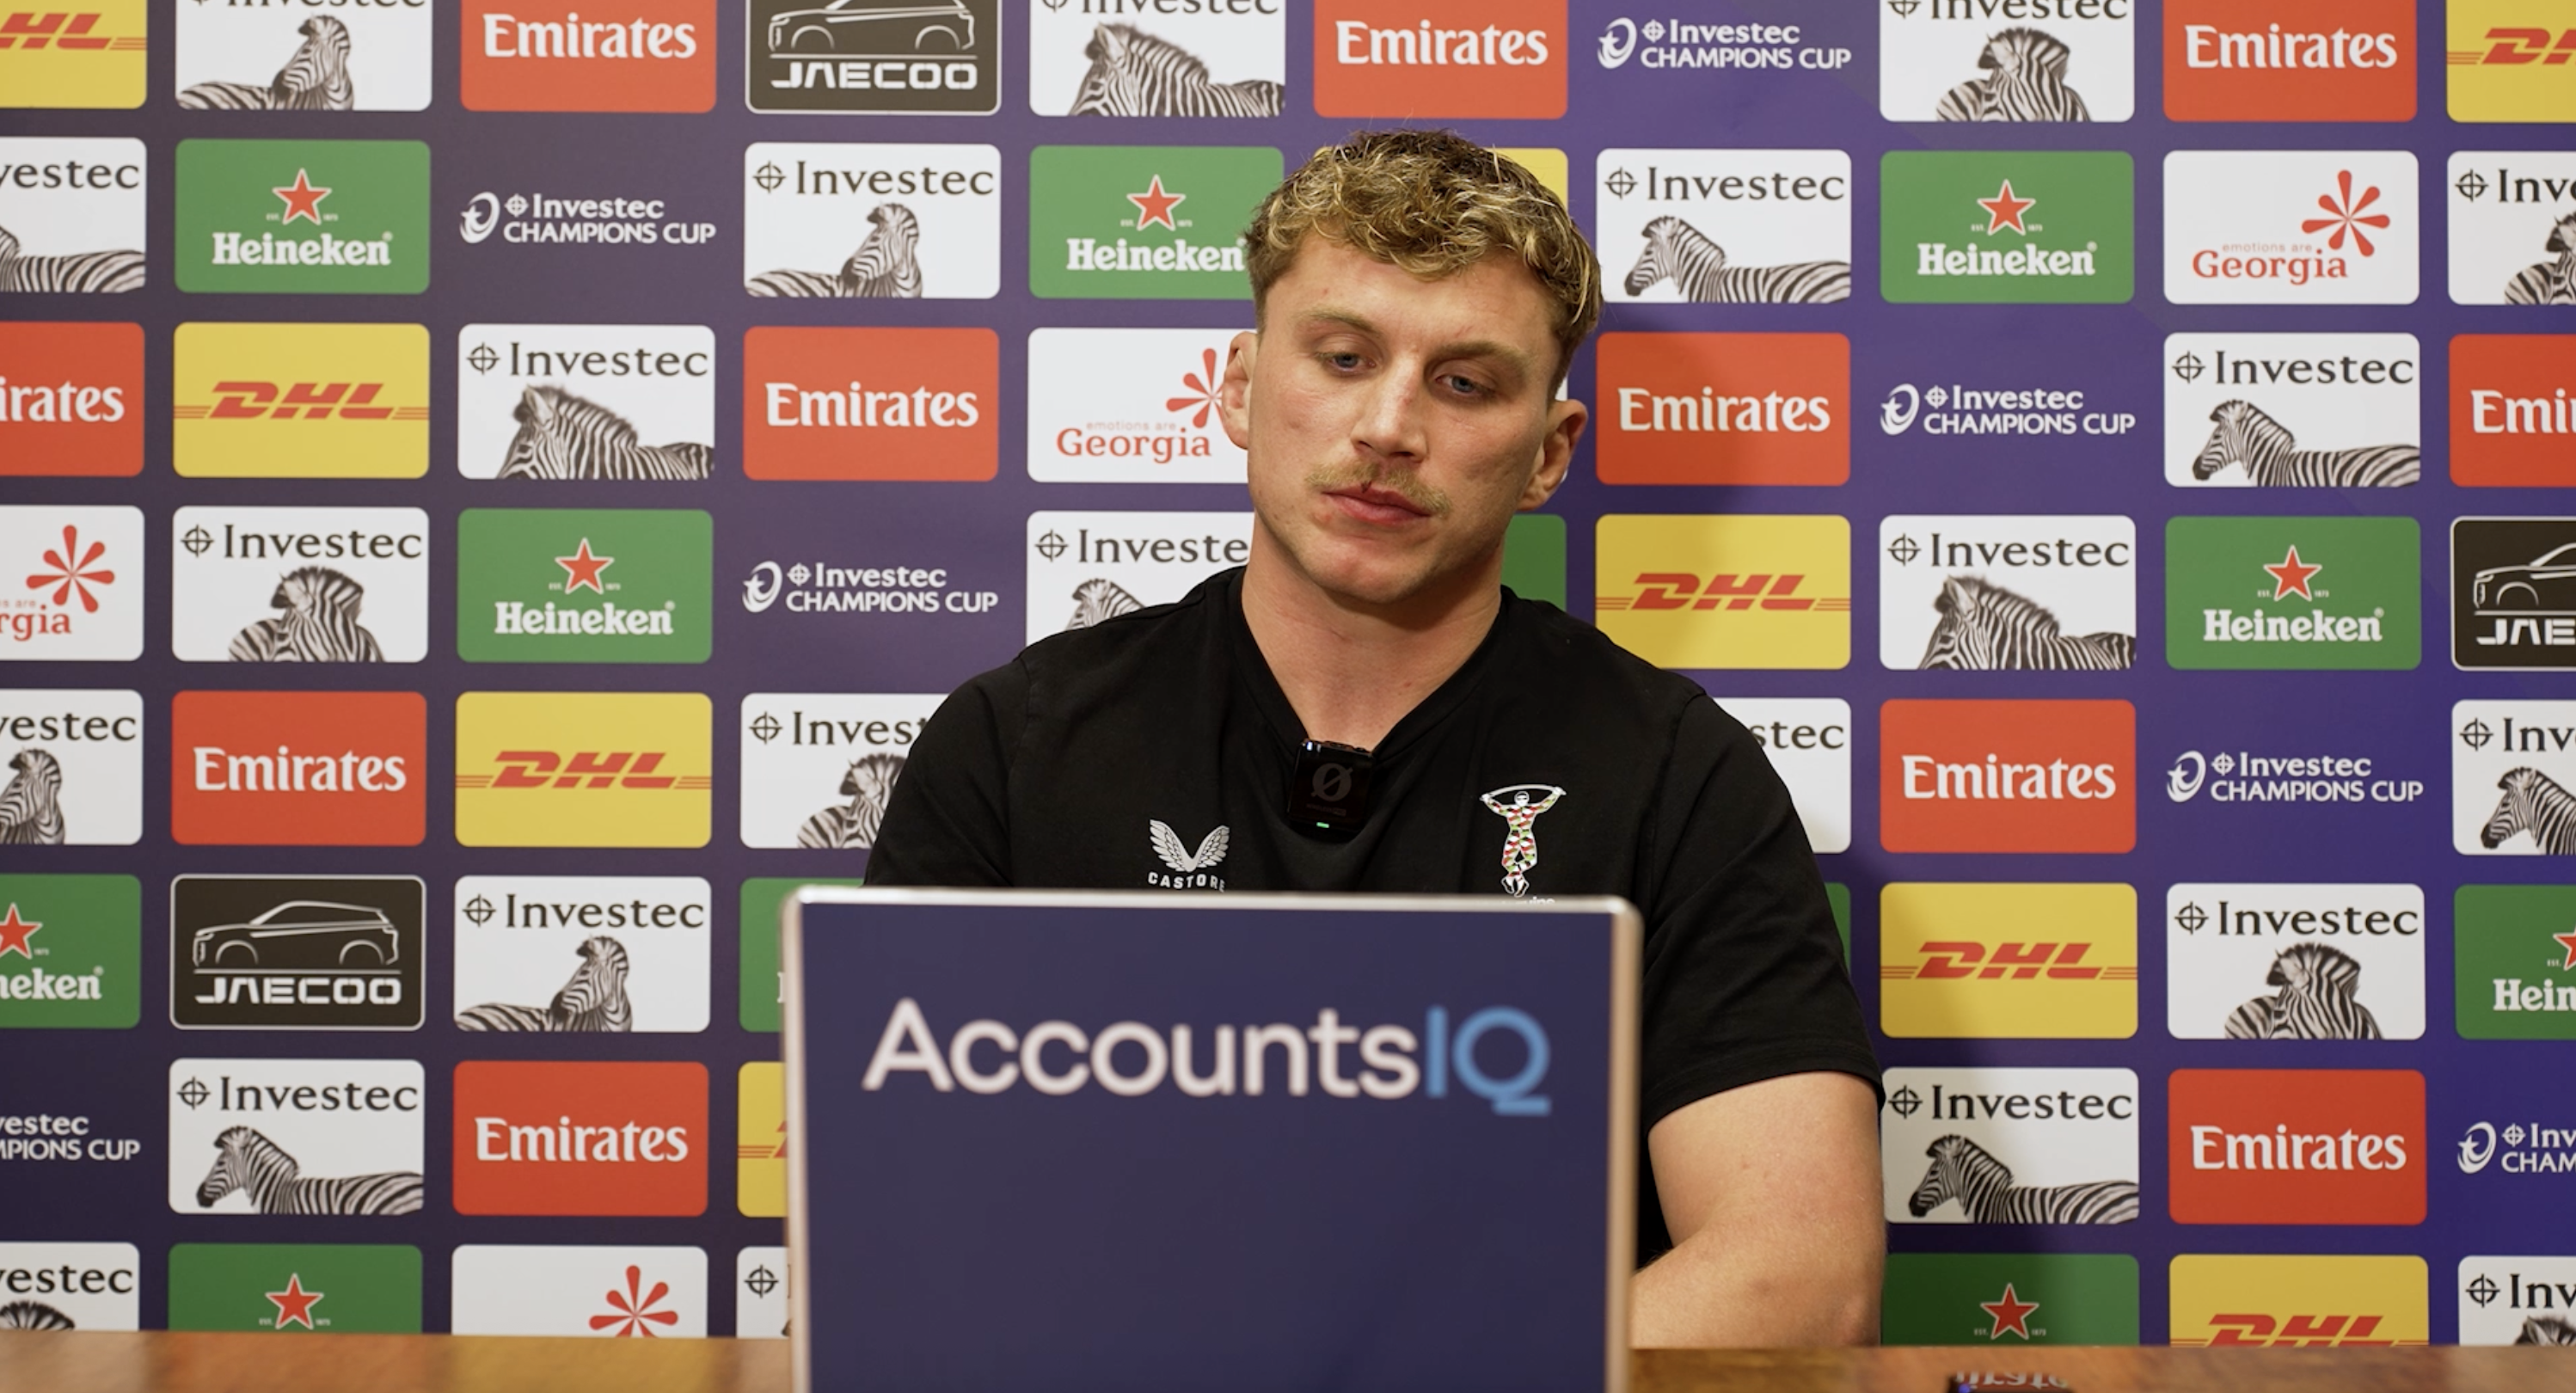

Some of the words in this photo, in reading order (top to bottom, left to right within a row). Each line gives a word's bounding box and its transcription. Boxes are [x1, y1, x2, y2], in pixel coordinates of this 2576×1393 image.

[482, 12, 697, 58] Emirates
[1335, 19, 1549, 65] Emirates
[1670, 18, 1800, 45] Investec
[2185, 22, 2398, 69] Emirates
[770, 61, 978, 90] JAECOO
[1641, 46, 1794, 69] CHAMPIONS
[1798, 47, 1852, 70] CUP
[797, 161, 993, 196] Investec
[1648, 166, 1844, 201] Investec
[2499, 169, 2576, 203] Inv
[533, 193, 665, 219] Investec
[503, 221, 658, 244] CHAMPIONS
[662, 222, 717, 244] CUP
[2222, 242, 2287, 253] emotions
[2291, 243, 2313, 253] are
[2192, 249, 2348, 286] Georgia
[511, 341, 708, 377] Investec
[2216, 350, 2413, 384] Investec
[209, 381, 395, 420] DHL
[765, 381, 979, 427] Emirates
[1618, 386, 1831, 433] Emirates
[1953, 384, 2083, 410] Investec
[2470, 388, 2576, 433] Emi
[1086, 420, 1150, 432] emotions
[1154, 422, 1177, 432] are
[1923, 413, 2077, 435] CHAMPIONS
[2082, 413, 2136, 435] CUP
[1056, 427, 1211, 465] Georgia
[224, 524, 421, 559] Investec
[1931, 533, 2129, 568] Investec
[815, 562, 947, 588] Investec
[1630, 572, 1815, 611] DHL
[785, 590, 941, 613] CHAMPIONS
[945, 591, 999, 613] CUP
[2476, 618, 2576, 646] JAE
[193, 745, 407, 792] Emirates
[490, 750, 677, 789] DHL
[1902, 753, 2116, 799] Emirates
[2240, 752, 2371, 777] Investec
[2210, 780, 2365, 802] CHAMPIONS
[2371, 780, 2424, 802] CUP
[1147, 870, 1226, 893] CASTORE
[506, 893, 704, 929] Investec
[2219, 901, 2418, 936] Investec
[1915, 941, 2104, 981] DHL
[195, 977, 402, 1005] JAECOO
[862, 997, 1551, 1115] AccountsIQ
[221, 1076, 418, 1112] Investec
[1931, 1083, 2131, 1120] Investec
[0, 1114, 89, 1136] estec
[475, 1115, 689, 1162] Emirates
[87, 1138, 141, 1161] CUP
[2190, 1124, 2407, 1170] Emirates
[0, 1265, 132, 1294] estec
